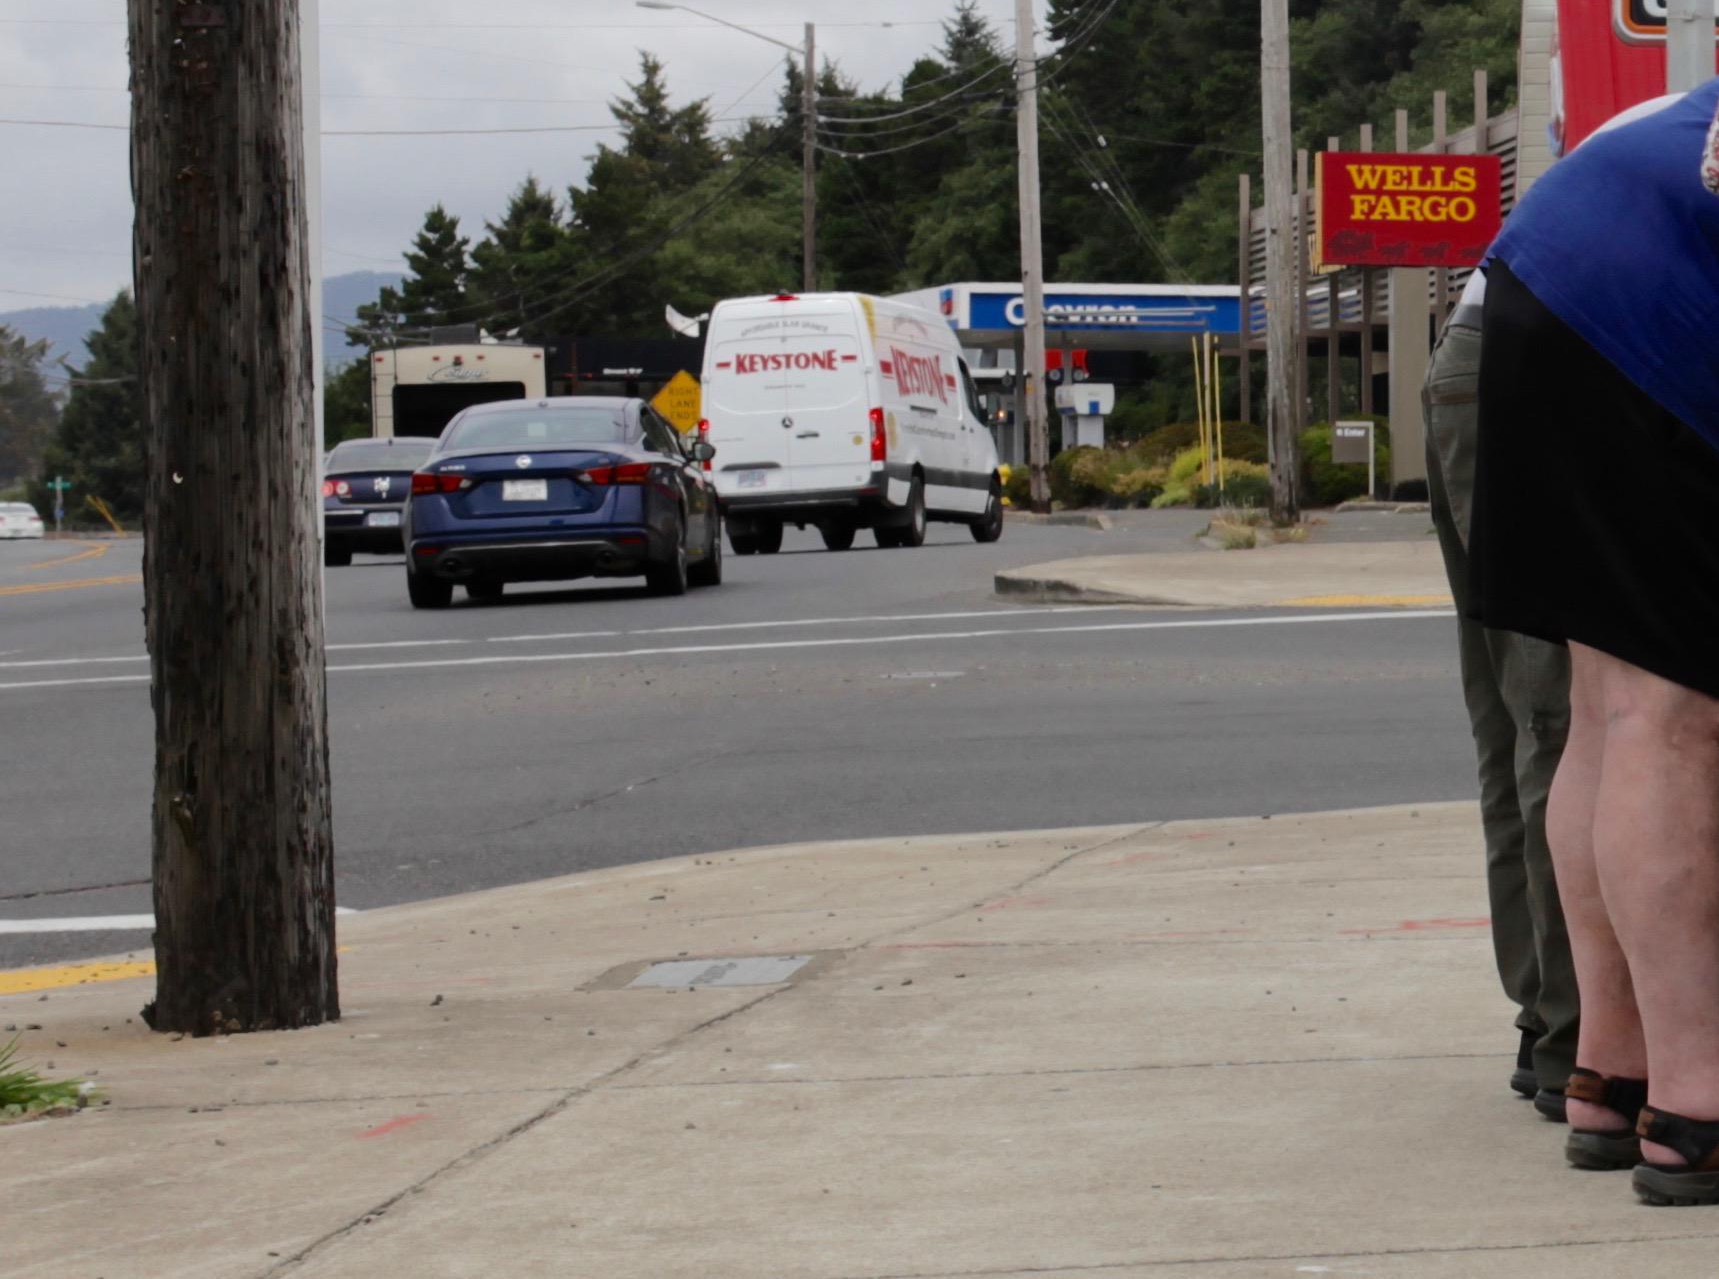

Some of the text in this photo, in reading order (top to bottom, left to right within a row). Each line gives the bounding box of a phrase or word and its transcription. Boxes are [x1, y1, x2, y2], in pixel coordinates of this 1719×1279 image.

[1345, 164, 1477, 192] WELLS
[1350, 194, 1476, 222] FARGO
[1005, 296, 1138, 326] Cevron
[735, 349, 838, 375] KEYSTONE
[891, 345, 948, 406] KEYSTONE
